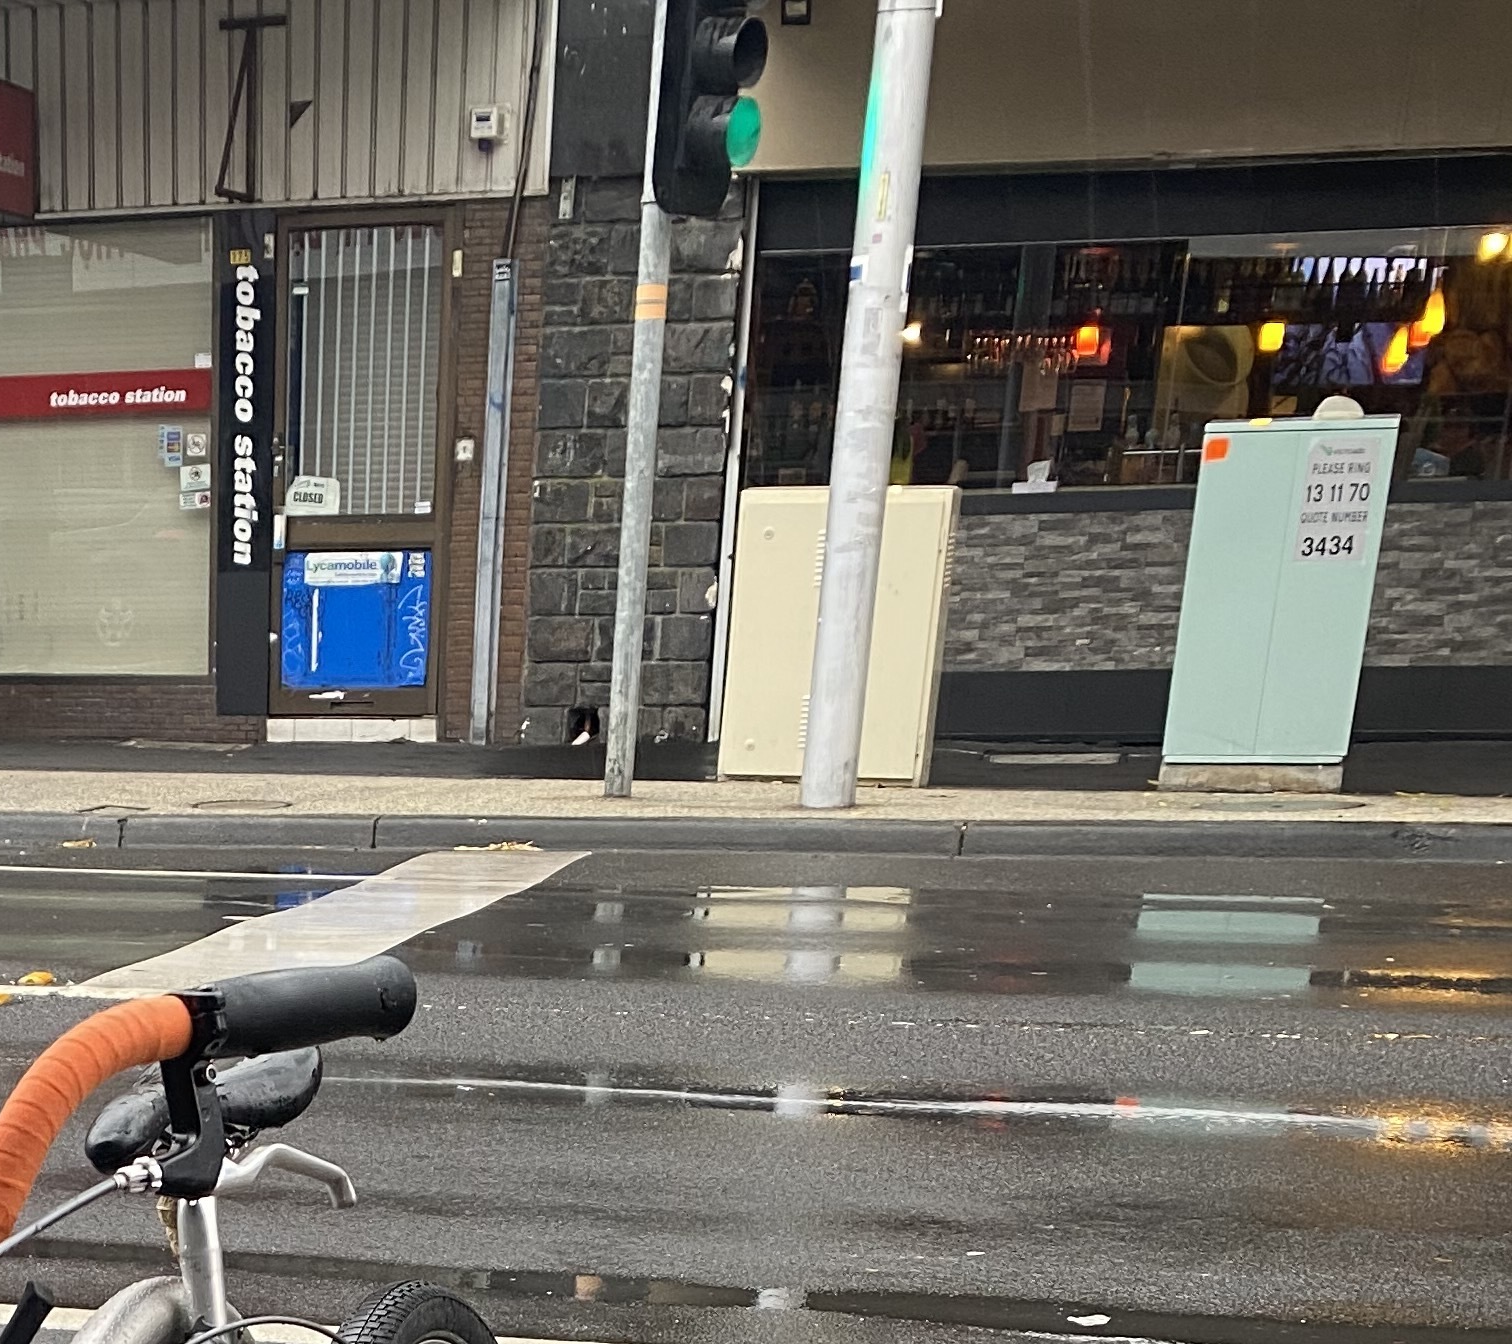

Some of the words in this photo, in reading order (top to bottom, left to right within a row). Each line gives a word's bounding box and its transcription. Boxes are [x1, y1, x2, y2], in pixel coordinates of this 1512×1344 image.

[234, 265, 261, 423] tobacco
[49, 389, 120, 407] tobacco
[125, 386, 187, 404] station
[1312, 462, 1346, 475] PLEASE
[1348, 462, 1371, 474] RING
[233, 434, 259, 566] station
[293, 491, 324, 504] CLOSED
[1306, 483, 1324, 503] 13
[1330, 483, 1344, 502] 11
[1349, 482, 1371, 502] 70
[1300, 511, 1329, 524] QUOTE
[1331, 510, 1368, 523] NUMBER
[1300, 535, 1355, 556] 3434
[306, 560, 378, 572] Lycamobile
